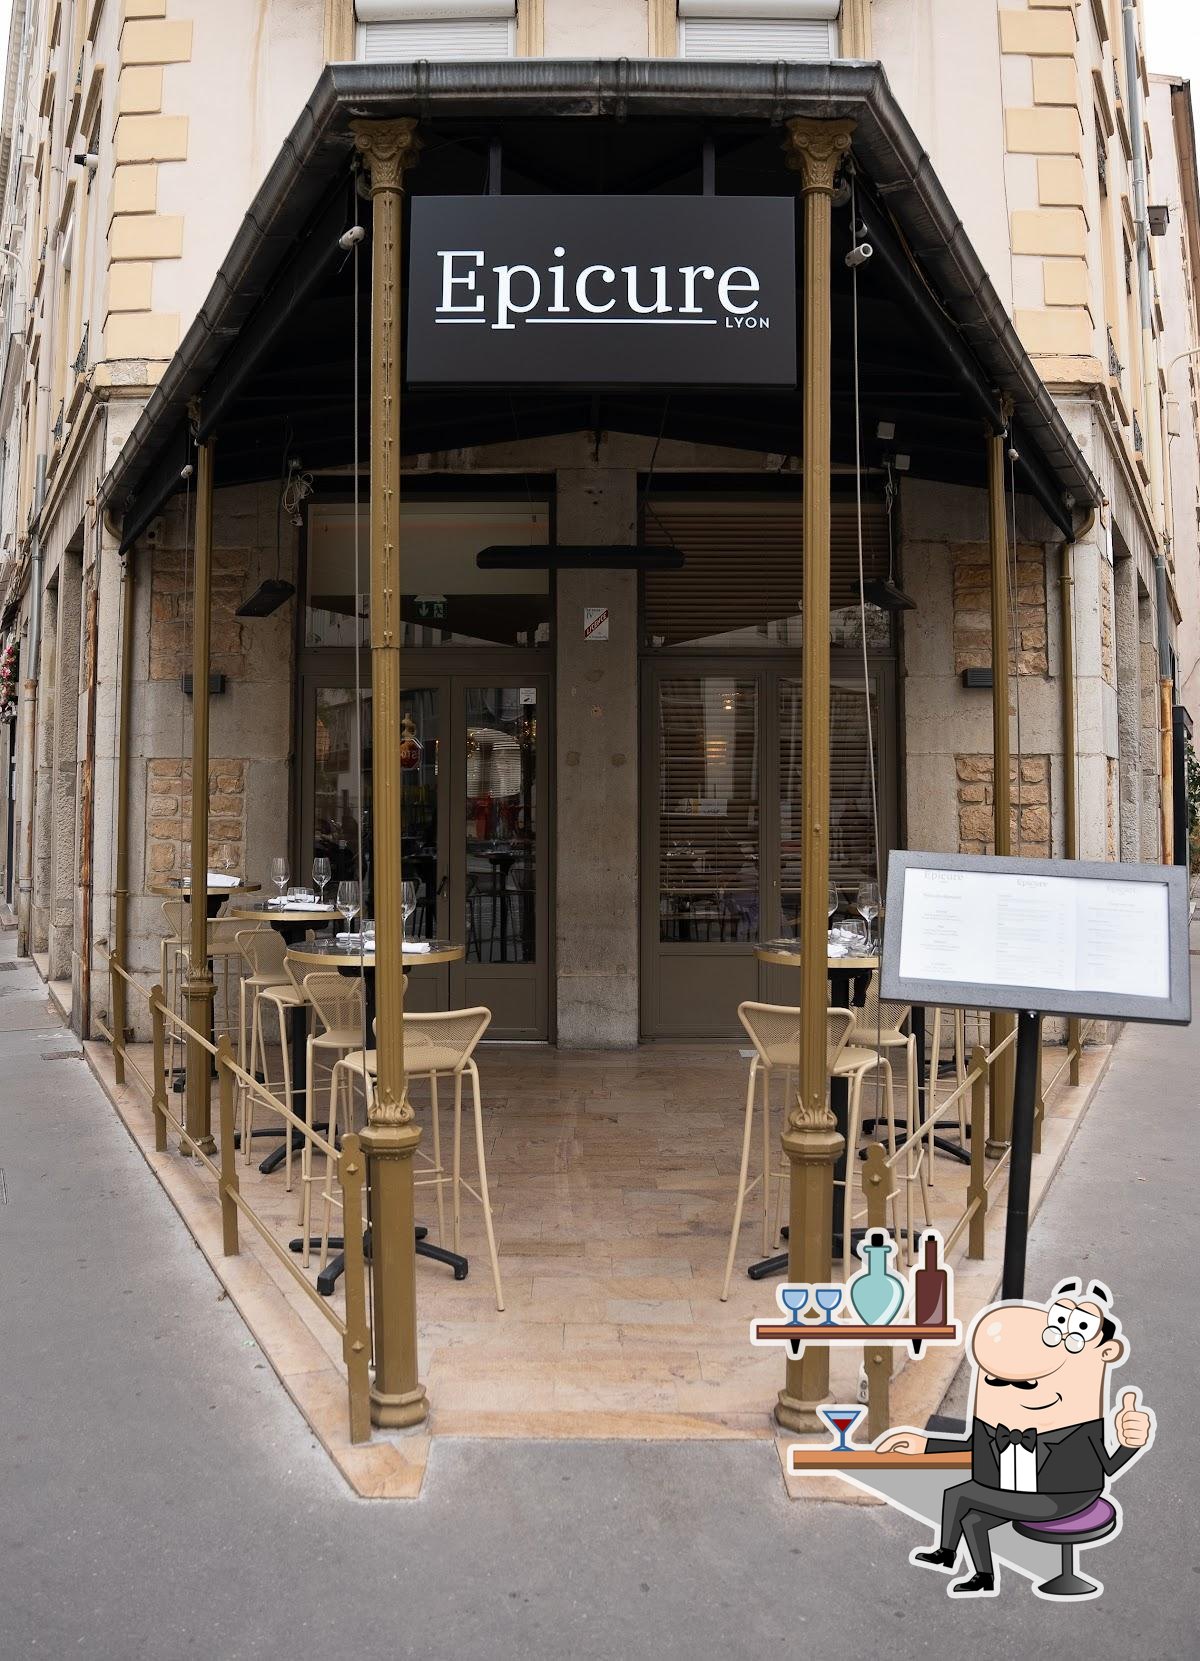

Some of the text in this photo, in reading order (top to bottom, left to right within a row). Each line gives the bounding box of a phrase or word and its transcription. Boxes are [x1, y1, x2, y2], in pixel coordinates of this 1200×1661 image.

[435, 246, 760, 329] Epicure
[725, 316, 771, 329] LYON
[586, 611, 608, 636] LICENCE
